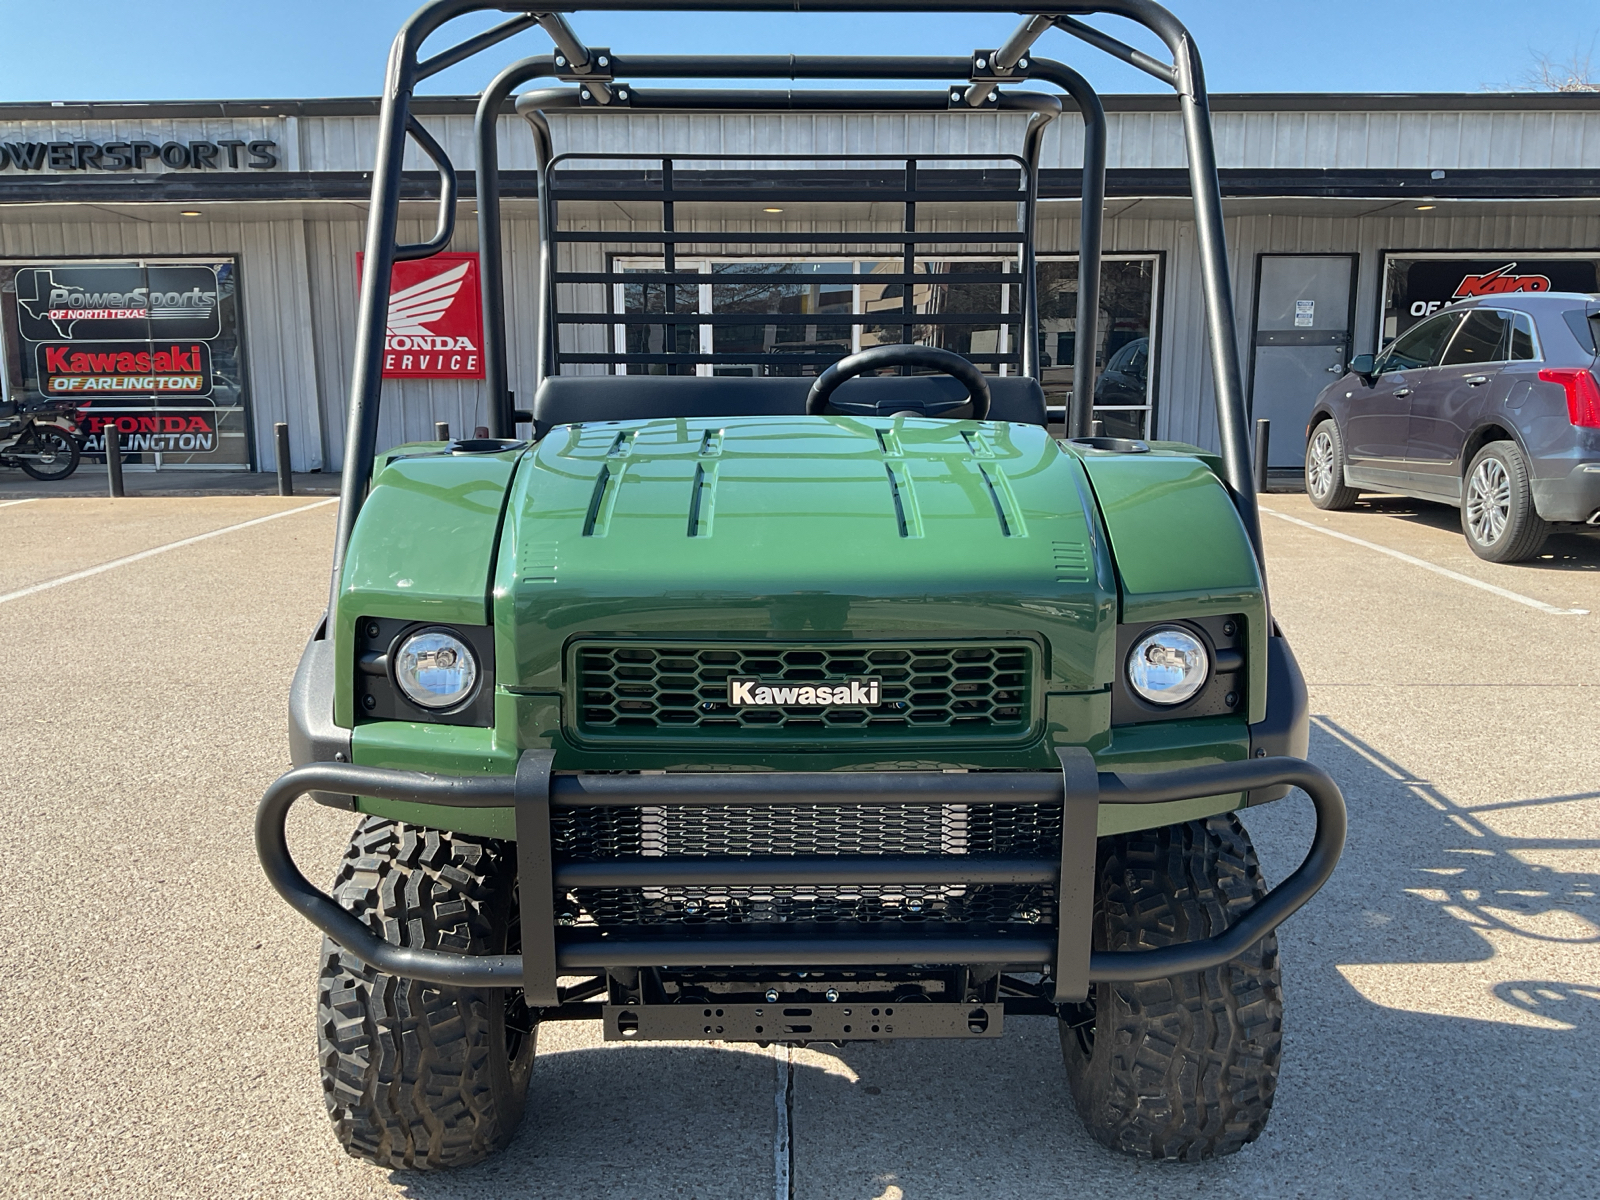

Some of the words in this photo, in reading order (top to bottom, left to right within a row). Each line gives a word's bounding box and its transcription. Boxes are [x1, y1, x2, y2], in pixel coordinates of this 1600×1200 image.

[49, 287, 216, 309] PowerSports
[50, 311, 67, 319] OF
[68, 310, 106, 319] NORTH
[108, 310, 146, 319] TEXAS
[1410, 301, 1440, 317] OF
[46, 345, 202, 373] Kawasaki
[385, 355, 477, 370] ERVICE
[53, 378, 83, 390] OF
[84, 377, 198, 389] ARLINGTON
[88, 416, 213, 433] HONDA
[732, 681, 879, 705] Kawasaki
